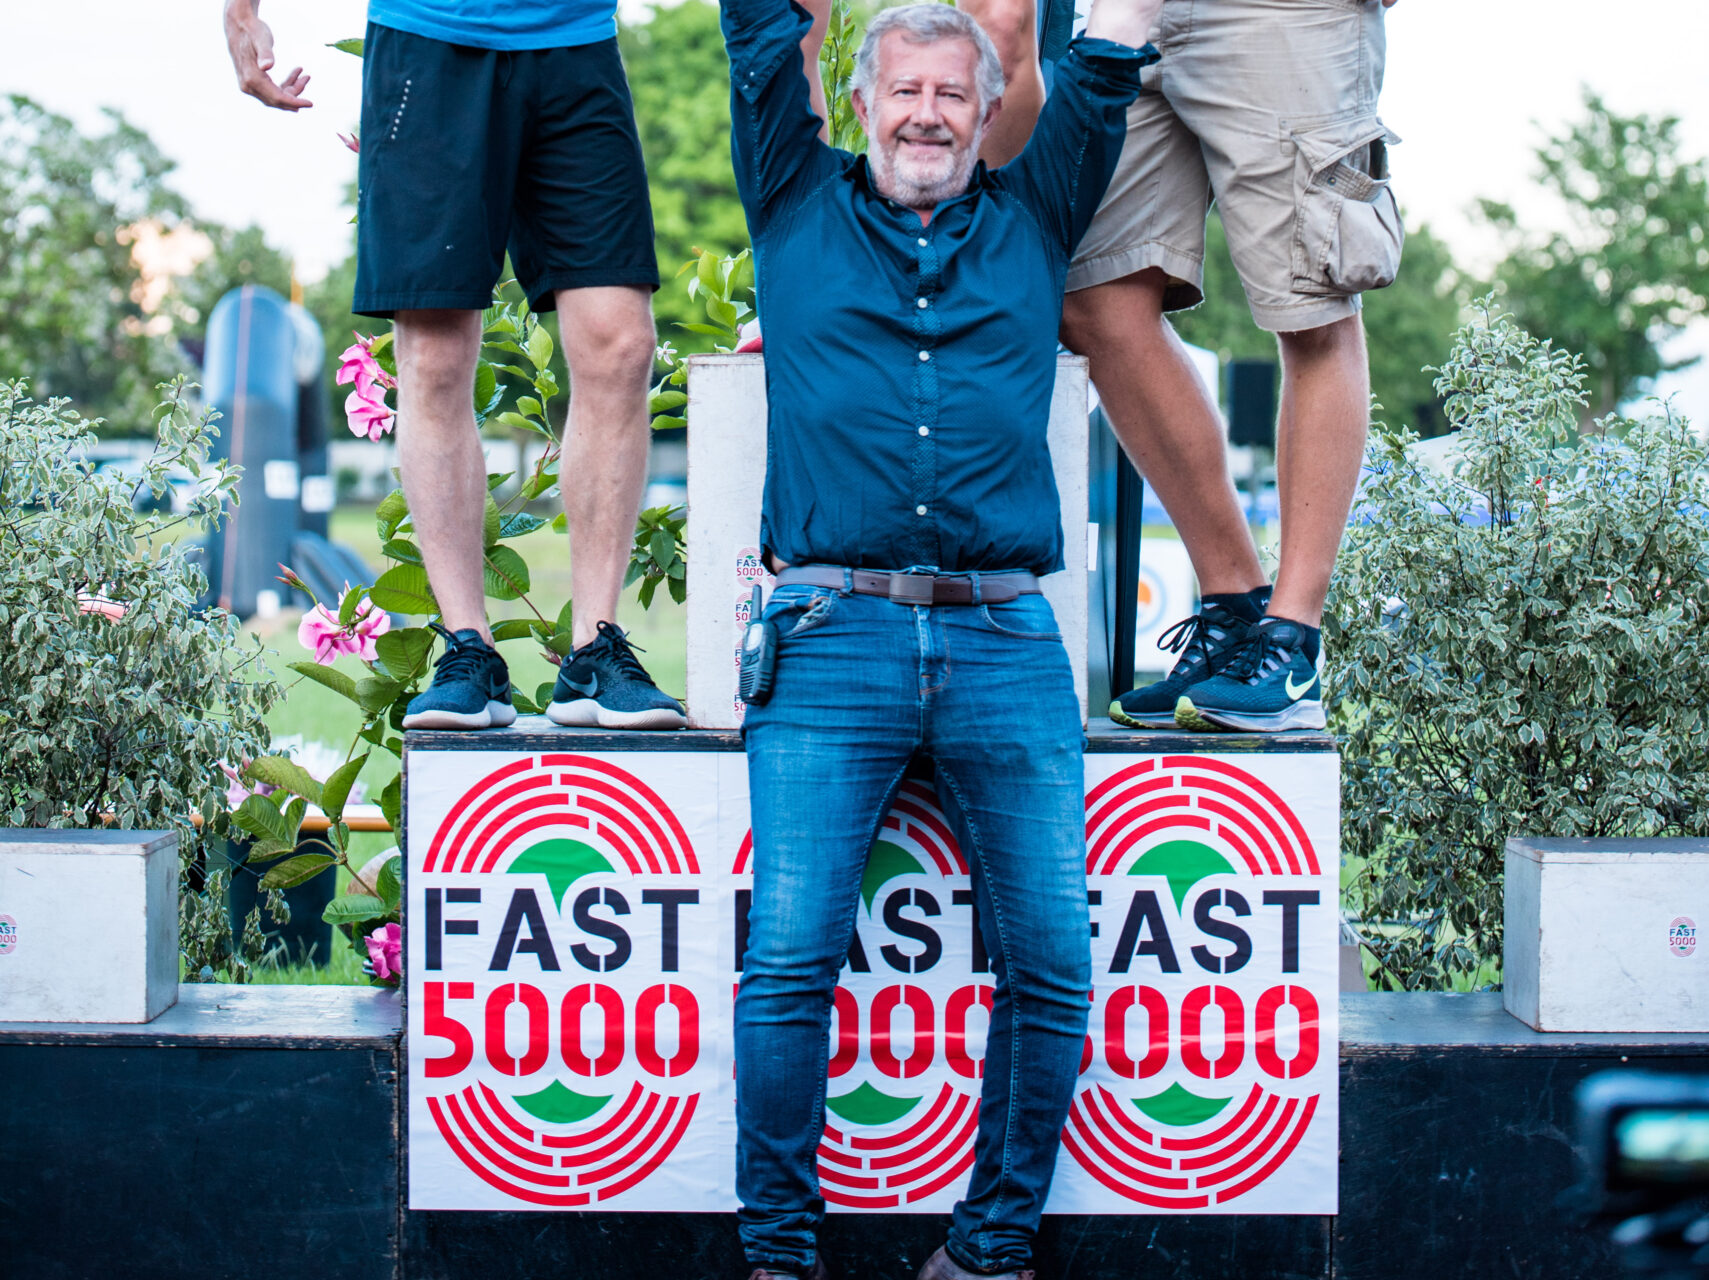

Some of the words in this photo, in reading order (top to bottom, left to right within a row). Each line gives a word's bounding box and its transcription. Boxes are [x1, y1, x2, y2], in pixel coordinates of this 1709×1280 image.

[736, 567, 763, 576] 5000
[424, 886, 700, 973] FAST
[1669, 928, 1697, 937] FAST
[1669, 936, 1696, 946] 5000
[423, 981, 700, 1079] 5000
[1078, 984, 1320, 1080] 000
